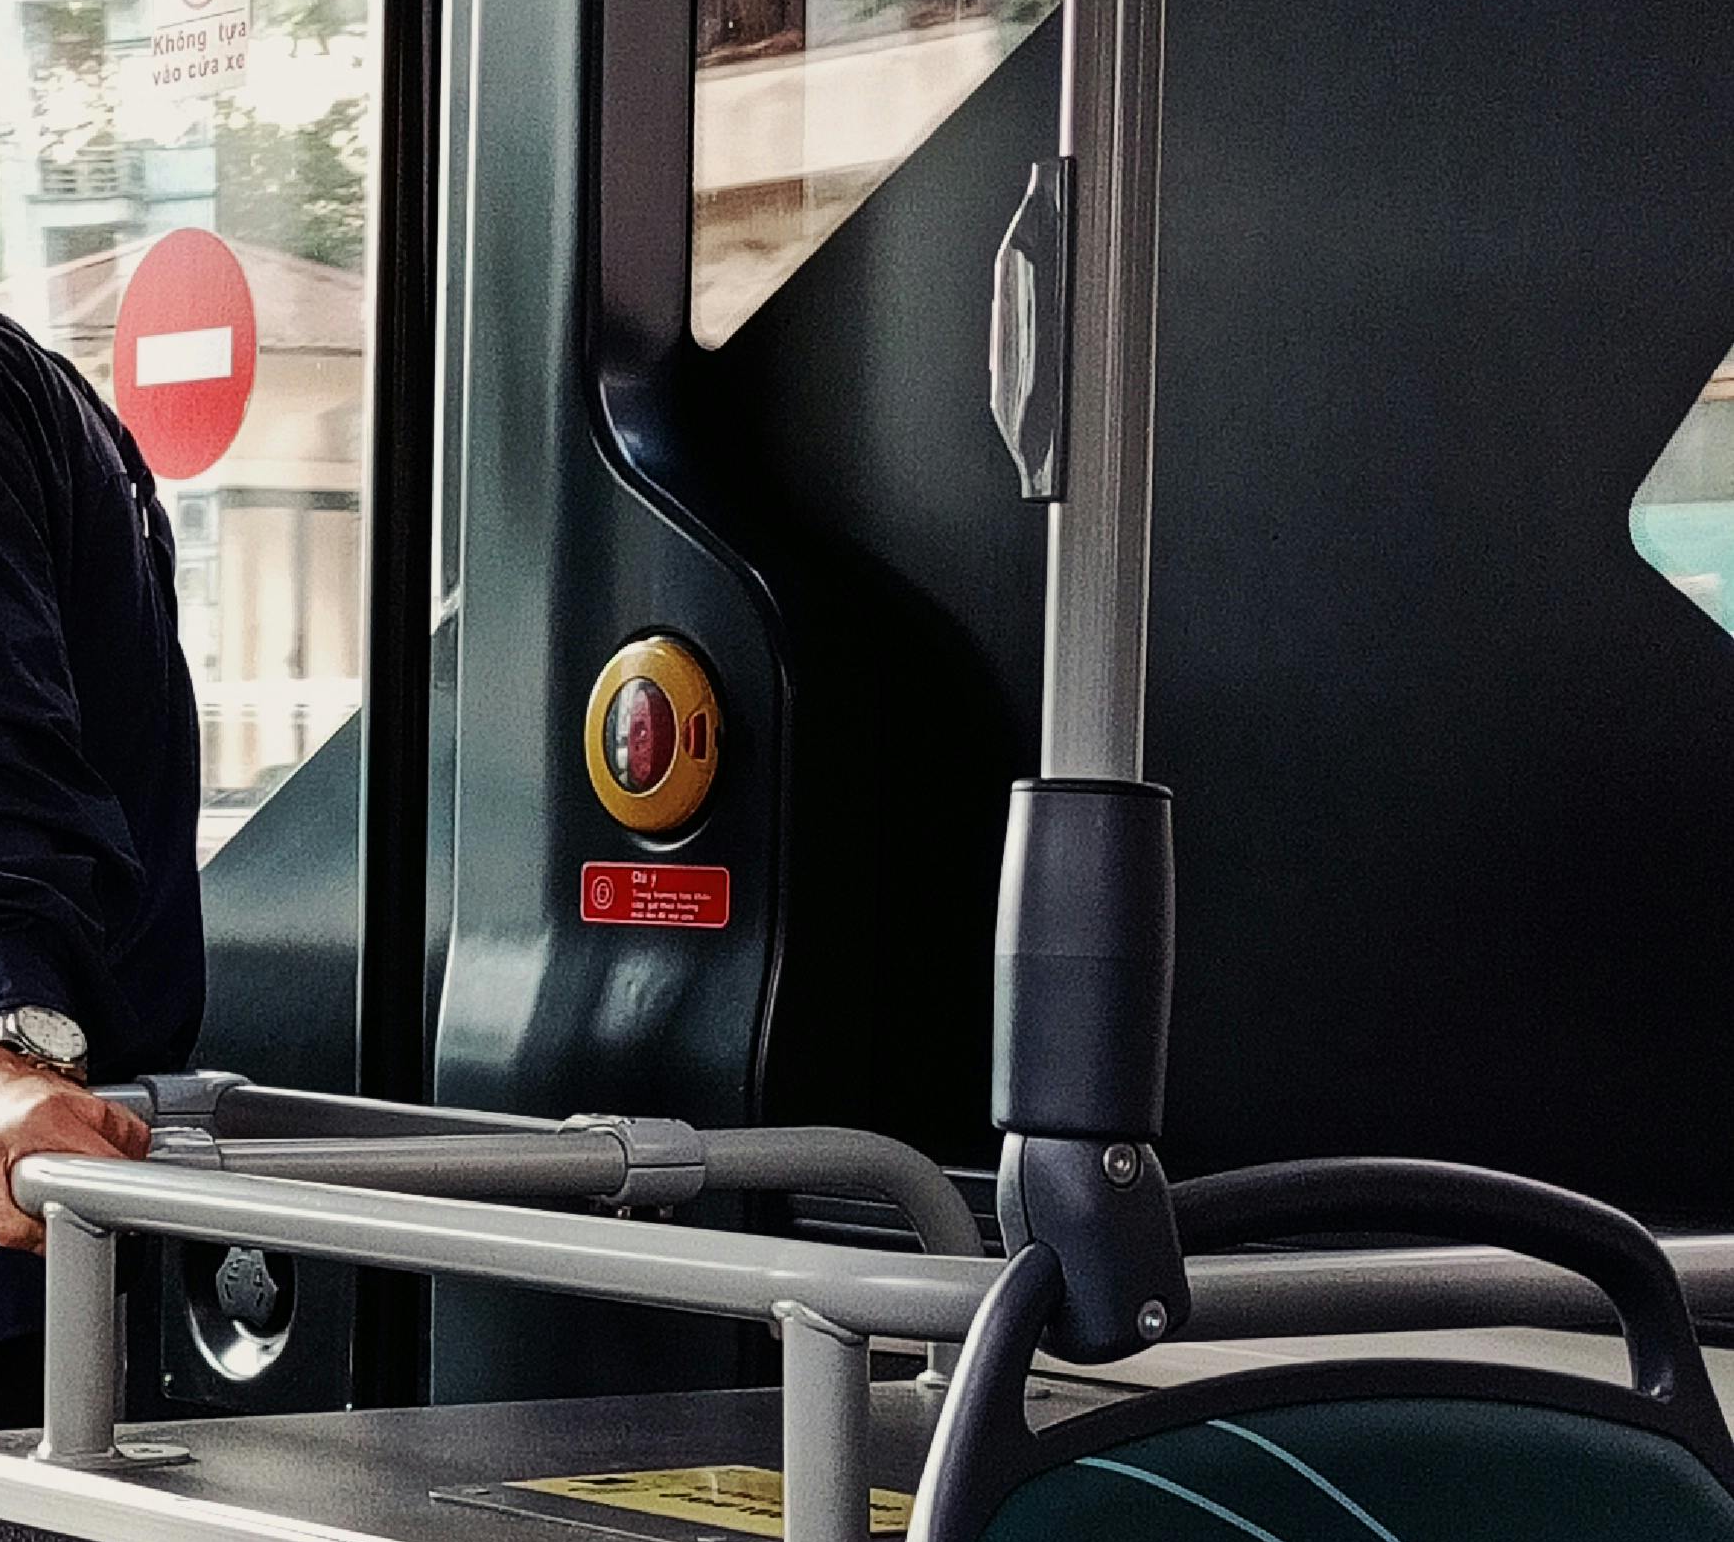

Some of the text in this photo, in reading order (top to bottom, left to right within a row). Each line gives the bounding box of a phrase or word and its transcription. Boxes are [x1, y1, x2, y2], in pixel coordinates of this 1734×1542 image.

[152, 20, 247, 57] Không tựa
[152, 52, 246, 86] vào cửa xe
